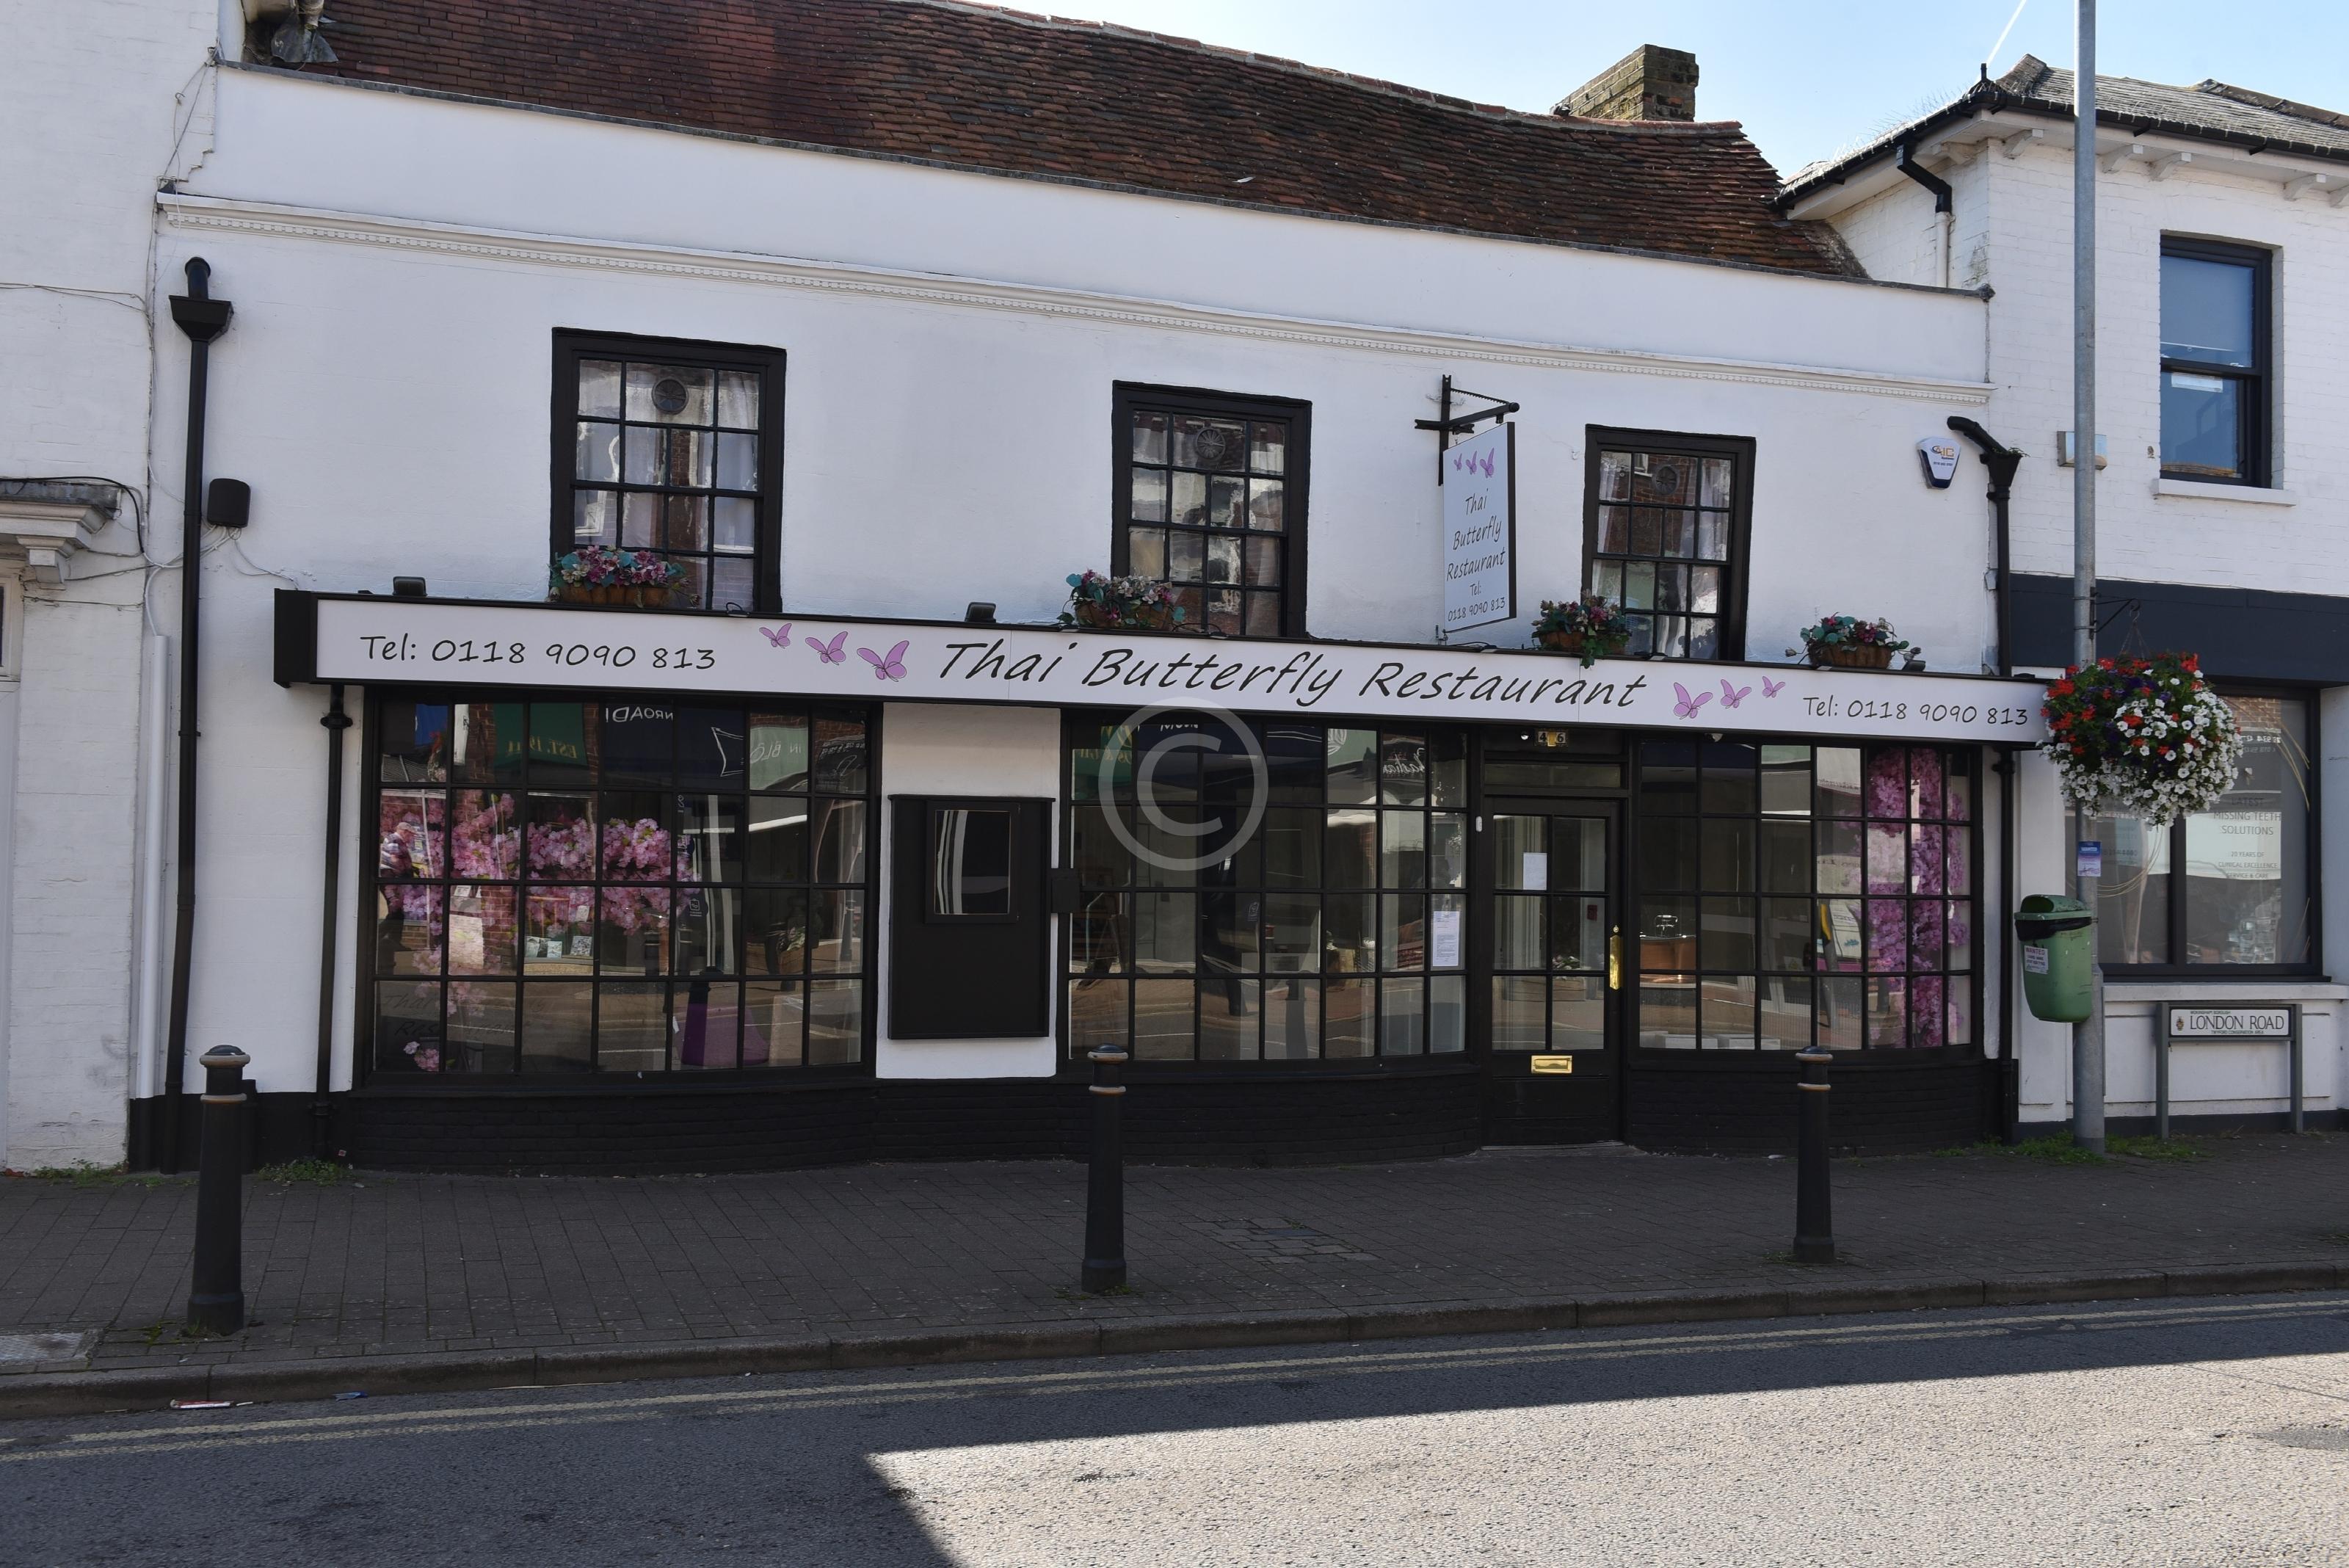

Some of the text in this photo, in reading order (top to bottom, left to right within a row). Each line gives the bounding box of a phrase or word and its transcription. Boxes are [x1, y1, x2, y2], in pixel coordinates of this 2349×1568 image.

[1465, 488, 1489, 515] Thai
[1453, 515, 1503, 551] Butterfly
[1446, 546, 1506, 582] Restaurant
[1470, 581, 1481, 597] Tel:
[1448, 596, 1506, 622] 0118 9090 813
[360, 633, 716, 669] Tel: 0118 9090 813
[940, 638, 1647, 707] Thai Butterfly Restaurant
[1803, 695, 2028, 725] Tel: 0118 9090 813
[2231, 796, 2265, 806] LATEST
[2213, 811, 2281, 821] MISSING TEETH
[2221, 825, 2273, 835] SOLUTIONS
[2190, 1015, 2284, 1030] LONDON ROAD
